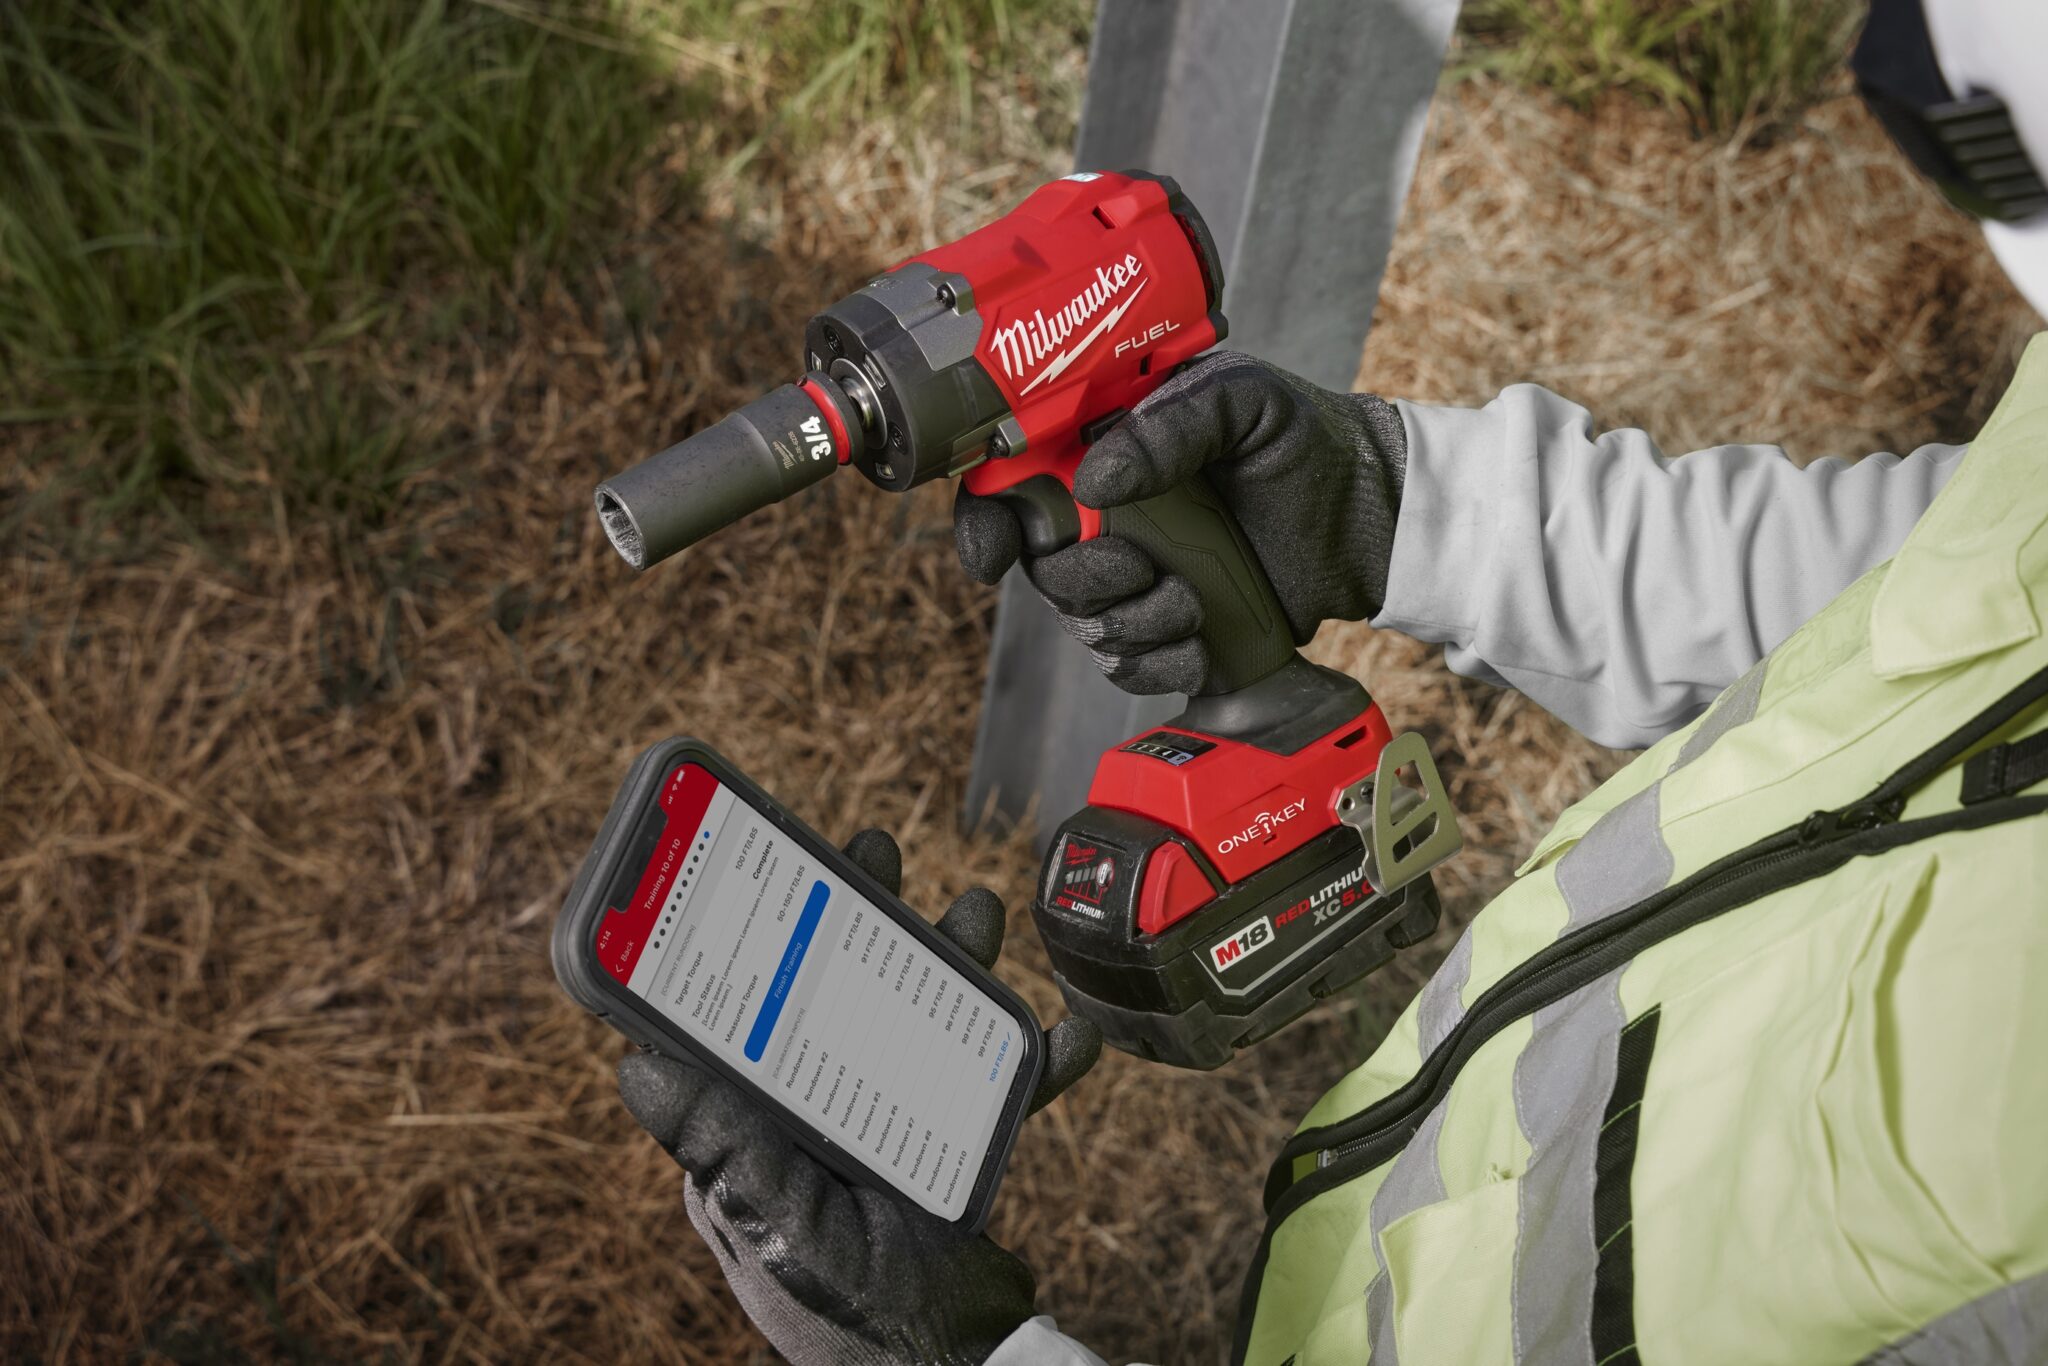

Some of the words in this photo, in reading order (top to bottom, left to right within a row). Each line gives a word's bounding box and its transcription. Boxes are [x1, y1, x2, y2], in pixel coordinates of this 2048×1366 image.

[990, 254, 1142, 381] Milwaukee
[1115, 319, 1181, 359] FUEL
[799, 415, 832, 461] 3/4
[735, 855, 745, 870] 100
[742, 826, 758, 855] FT/LBS
[752, 840, 773, 879] Complete
[643, 874, 665, 909] Training
[661, 861, 670, 872] 10
[667, 850, 675, 861] of
[671, 838, 680, 849] 10
[789, 865, 805, 893] FT/LBS
[1055, 895, 1105, 920] REDLITHIUM
[1274, 865, 1366, 929] REDLITHIU
[599, 930, 611, 949] 4:14
[620, 941, 634, 962] Back
[843, 939, 851, 951] 90
[848, 911, 863, 939] FT/LBS
[861, 953, 869, 963] 91
[865, 925, 880, 953] FT/LBS
[1215, 921, 1269, 967] M18
[674, 979, 691, 1005] Target
[686, 951, 703, 978] Torque
[774, 974, 788, 999] Finish
[784, 942, 802, 972] Training
[878, 966, 886, 978] 92
[882, 939, 897, 967] FT/LBS
[894, 980, 903, 992] 93
[899, 952, 914, 980] FT/LBS
[691, 1000, 703, 1018] Tool
[700, 974, 715, 1000] Status
[911, 993, 920, 1005] 94
[916, 966, 931, 993] FT/LBS
[928, 1006, 936, 1018] 95
[933, 979, 947, 1007] FT/LBS
[724, 1002, 746, 1043] Measured
[742, 974, 758, 1001] Torque
[945, 1020, 953, 1032] 96
[949, 992, 964, 1020] FT/LBS
[961, 1032, 969, 1045] 99
[966, 1005, 980, 1033] FT/LBS
[977, 1045, 985, 1057] 99
[982, 1018, 996, 1046] FT/LBS
[785, 1051, 805, 1088] Rundown
[802, 1039, 810, 1050] #1
[804, 1064, 823, 1102] Rundown
[820, 1051, 828, 1063] #2
[989, 1067, 998, 1082] 100
[994, 1040, 1008, 1067] FT/LBS
[822, 1078, 841, 1115] Rundown
[838, 1064, 846, 1076] #3
[839, 1091, 858, 1128] Rundown
[856, 1078, 863, 1090] #4
[857, 1104, 876, 1141] Rundown
[873, 1091, 881, 1103] #5
[874, 1117, 893, 1154] Rundown
[890, 1105, 898, 1116] #6
[892, 1130, 910, 1167] Rundown
[907, 1116, 914, 1129] #7
[909, 1143, 927, 1179] Rundown
[924, 1129, 932, 1141] #8
[926, 1155, 944, 1192] Rundown
[941, 1142, 948, 1154] #9
[943, 1168, 960, 1205] Rundown
[958, 1150, 967, 1166] #10
